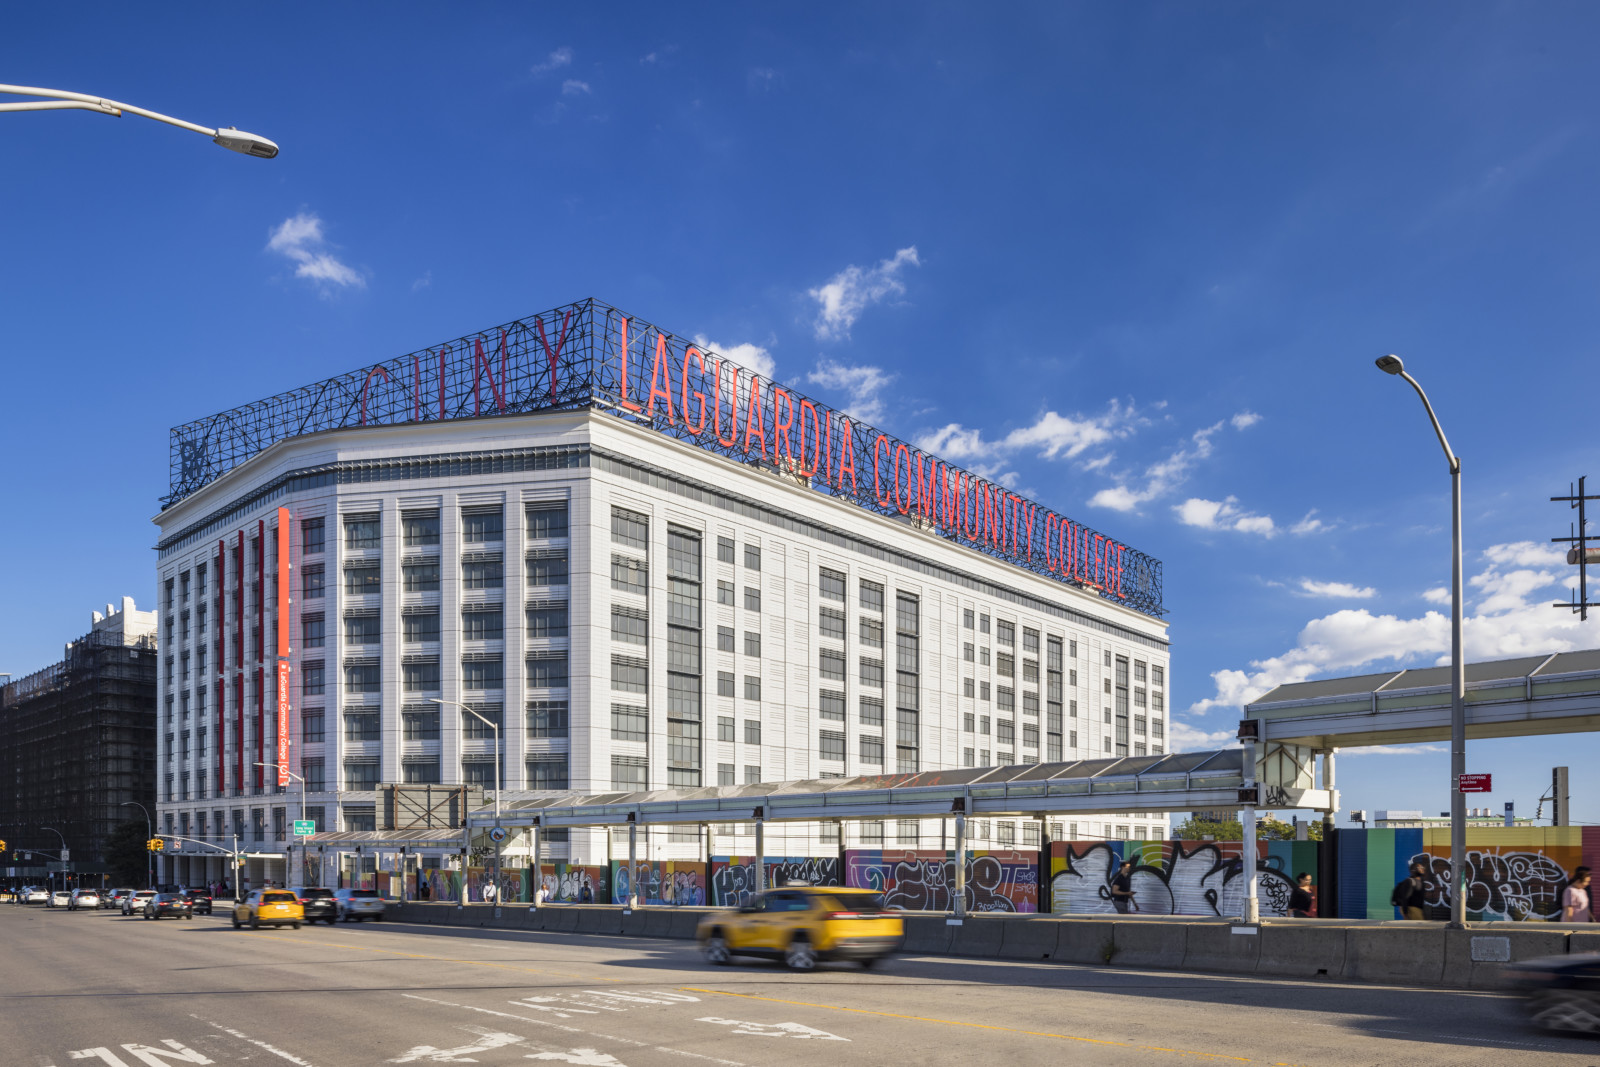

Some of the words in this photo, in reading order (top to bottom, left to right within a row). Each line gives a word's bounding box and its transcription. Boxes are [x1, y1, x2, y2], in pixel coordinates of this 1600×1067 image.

[621, 317, 858, 495] LAGUARDIA
[874, 435, 1036, 562] COMMUNITY
[1046, 513, 1126, 599] COLLEGE
[279, 703, 287, 736] Community
[279, 738, 287, 760] College
